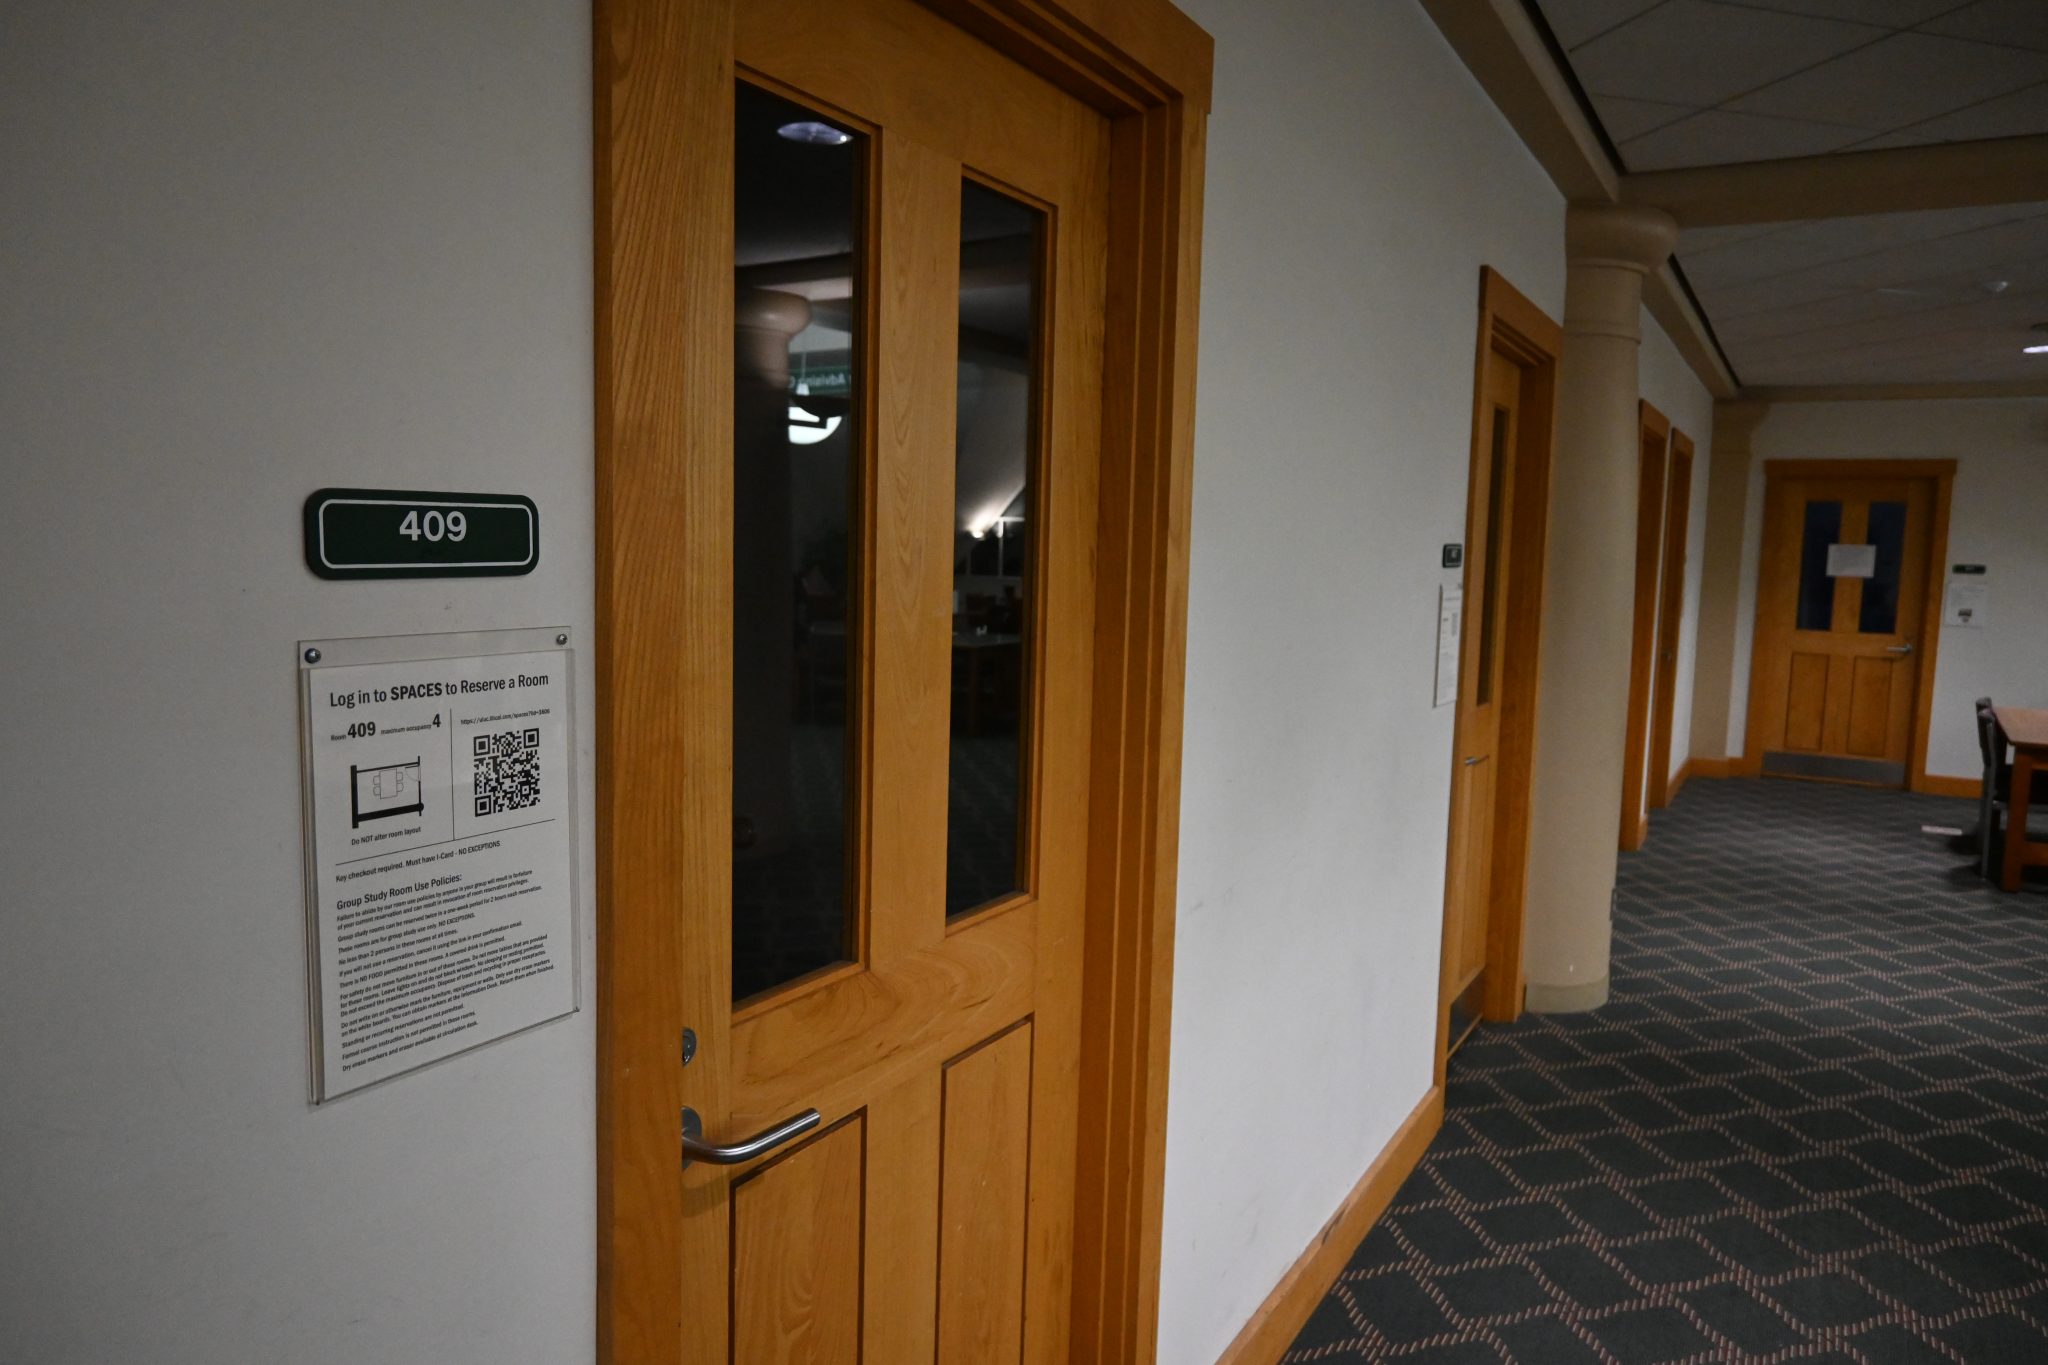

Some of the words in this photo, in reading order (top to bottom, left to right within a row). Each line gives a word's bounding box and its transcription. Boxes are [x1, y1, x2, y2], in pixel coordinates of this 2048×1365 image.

[399, 510, 467, 542] 409
[330, 693, 355, 708] Log
[358, 691, 370, 704] in
[374, 689, 386, 703] to
[390, 683, 443, 701] SPACES
[446, 682, 458, 695] to
[461, 680, 505, 694] Reserve
[508, 679, 514, 689] a
[517, 675, 548, 688] Room
[331, 733, 347, 741] Room
[347, 720, 376, 739] 409
[432, 712, 442, 728] 4
[404, 826, 421, 835] layout
[348, 867, 376, 879] checkout
[377, 861, 404, 873] required.
[406, 857, 420, 866] Must
[422, 855, 435, 863] have
[436, 850, 454, 860] I-Card
[458, 847, 466, 855] NO
[468, 840, 500, 852] EXCEPTIONS
[336, 897, 362, 910] Group
[364, 890, 387, 903] Study
[389, 885, 412, 897] Room
[414, 881, 429, 891] Use
[431, 874, 462, 887] Policies:
